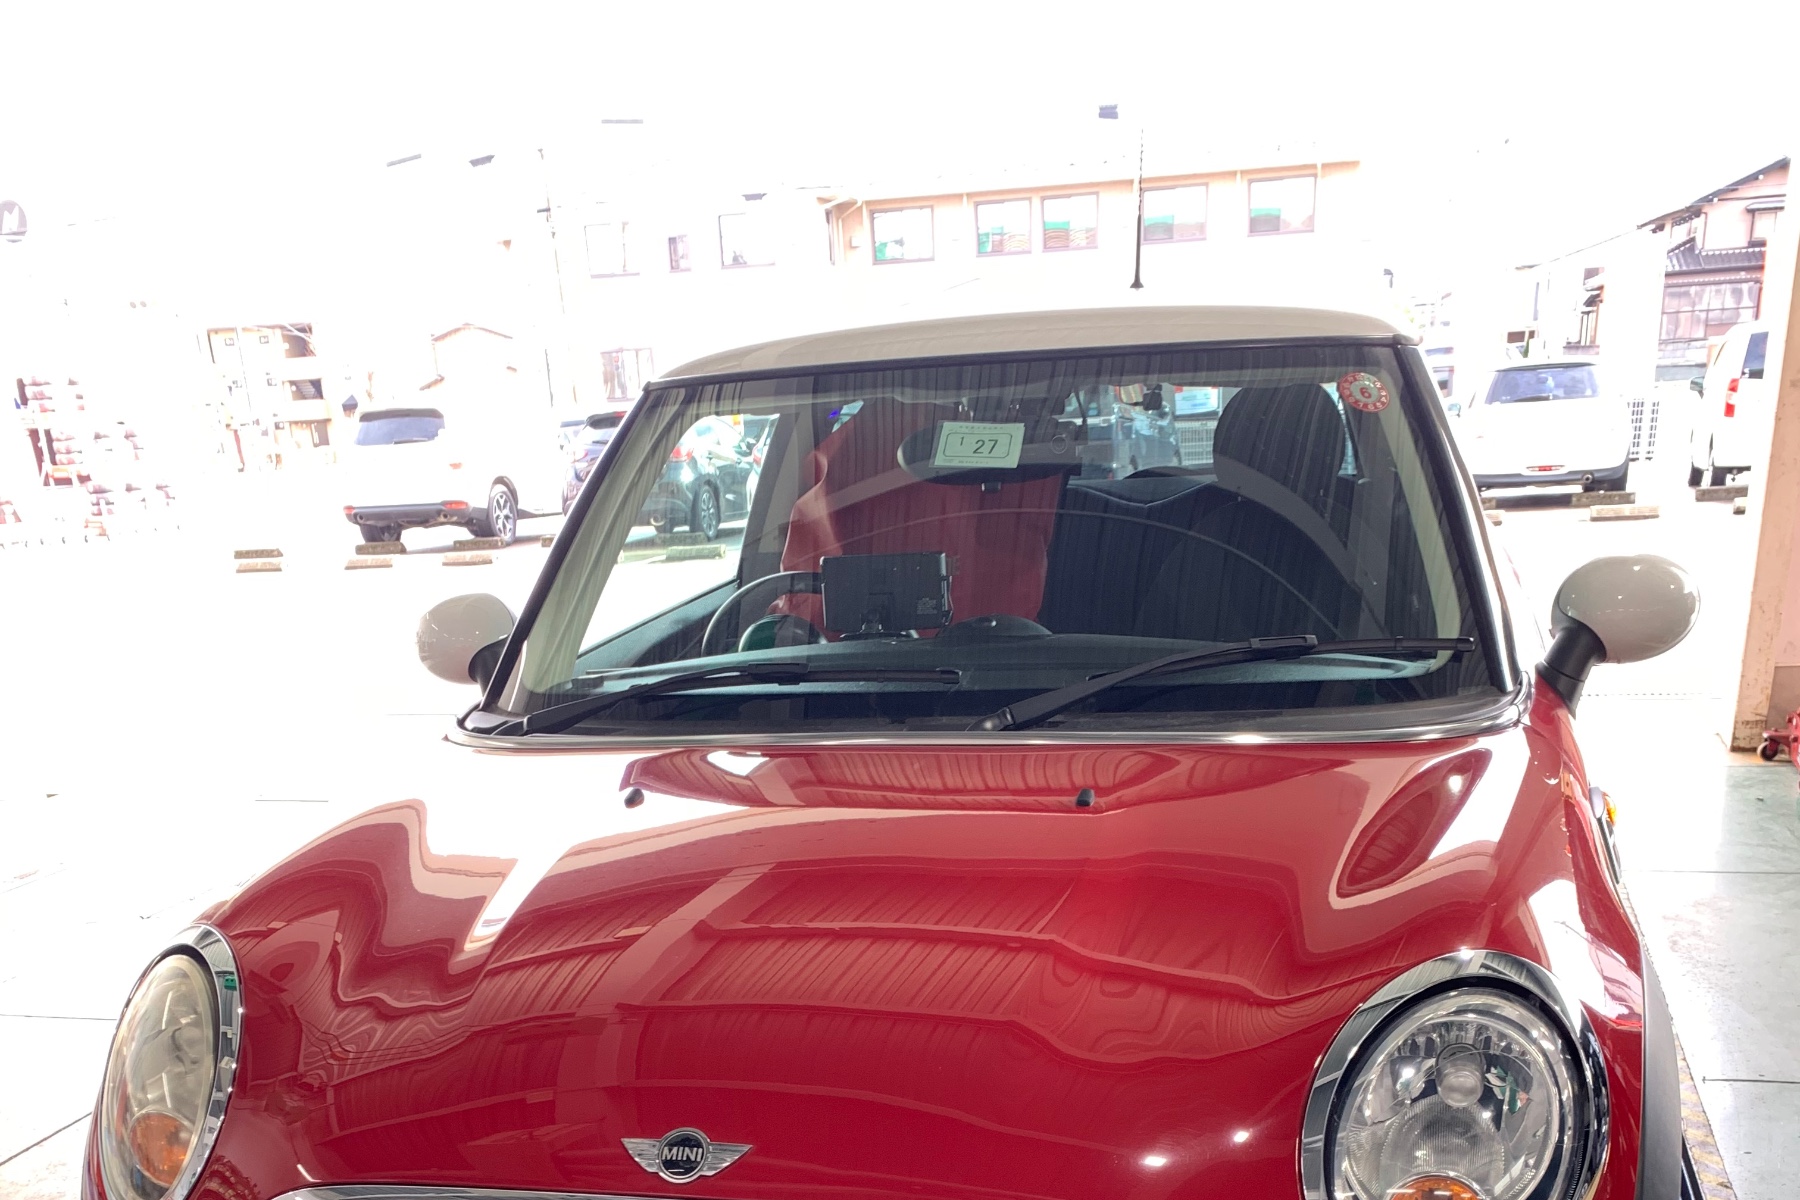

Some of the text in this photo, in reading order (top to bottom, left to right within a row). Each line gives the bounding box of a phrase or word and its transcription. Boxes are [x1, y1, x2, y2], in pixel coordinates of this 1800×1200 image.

[1359, 386, 1372, 399] 6
[972, 439, 999, 455] 27
[660, 1146, 703, 1162] MINI
